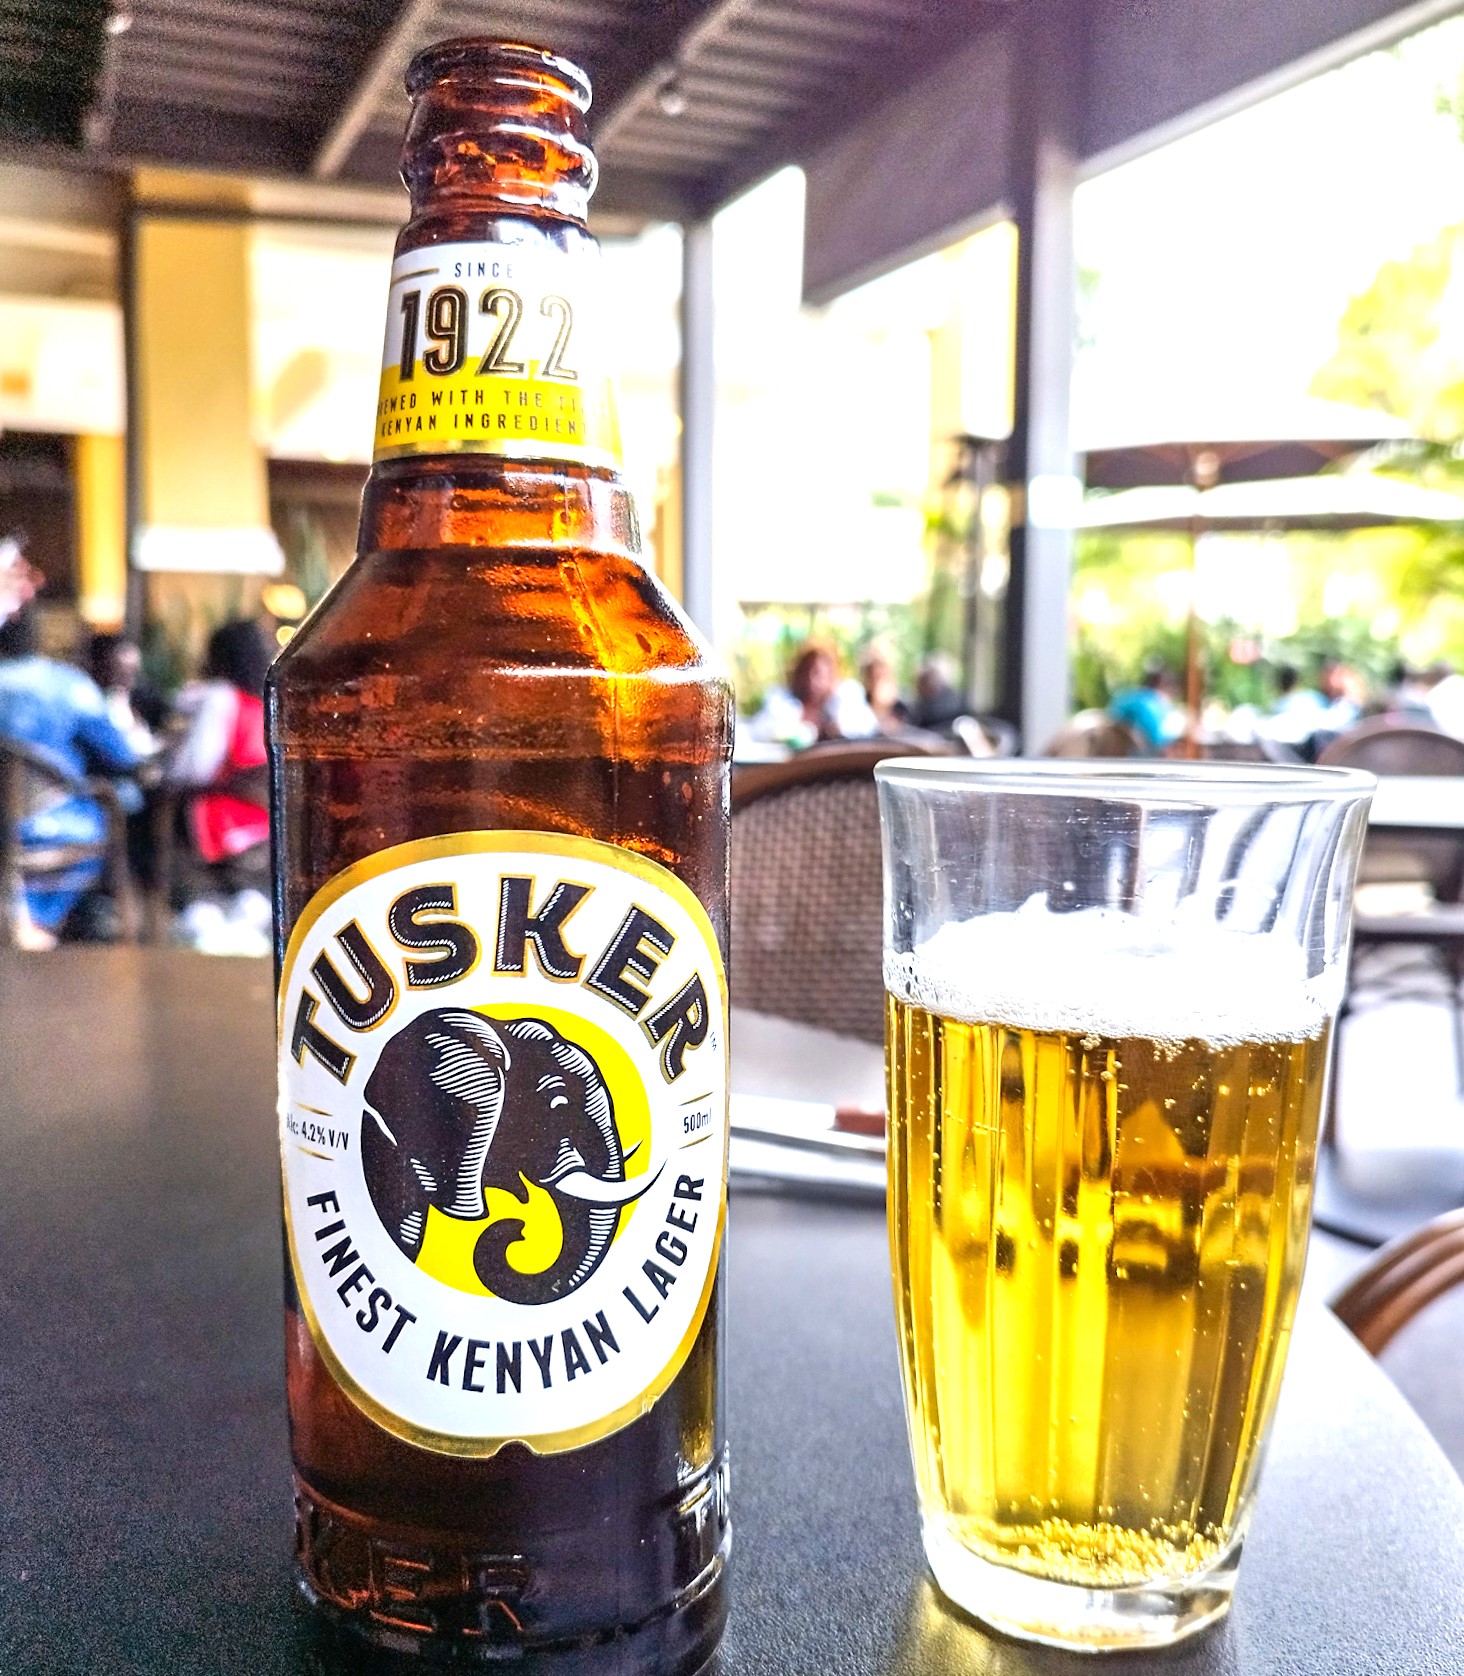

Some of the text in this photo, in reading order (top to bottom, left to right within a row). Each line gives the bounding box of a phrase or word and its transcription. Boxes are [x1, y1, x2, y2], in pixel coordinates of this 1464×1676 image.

[454, 262, 513, 279] SINCE
[399, 284, 579, 383] 1922
[431, 389, 484, 406] WITH
[503, 389, 543, 409] THE
[381, 413, 437, 438] KENYAN
[290, 873, 710, 1086] TUSKER
[683, 1107, 712, 1134] 500ml
[301, 1120, 326, 1146] 4.2%
[328, 1128, 349, 1151] V/V
[306, 1174, 706, 1394] FINEST KENYAN LAGER
